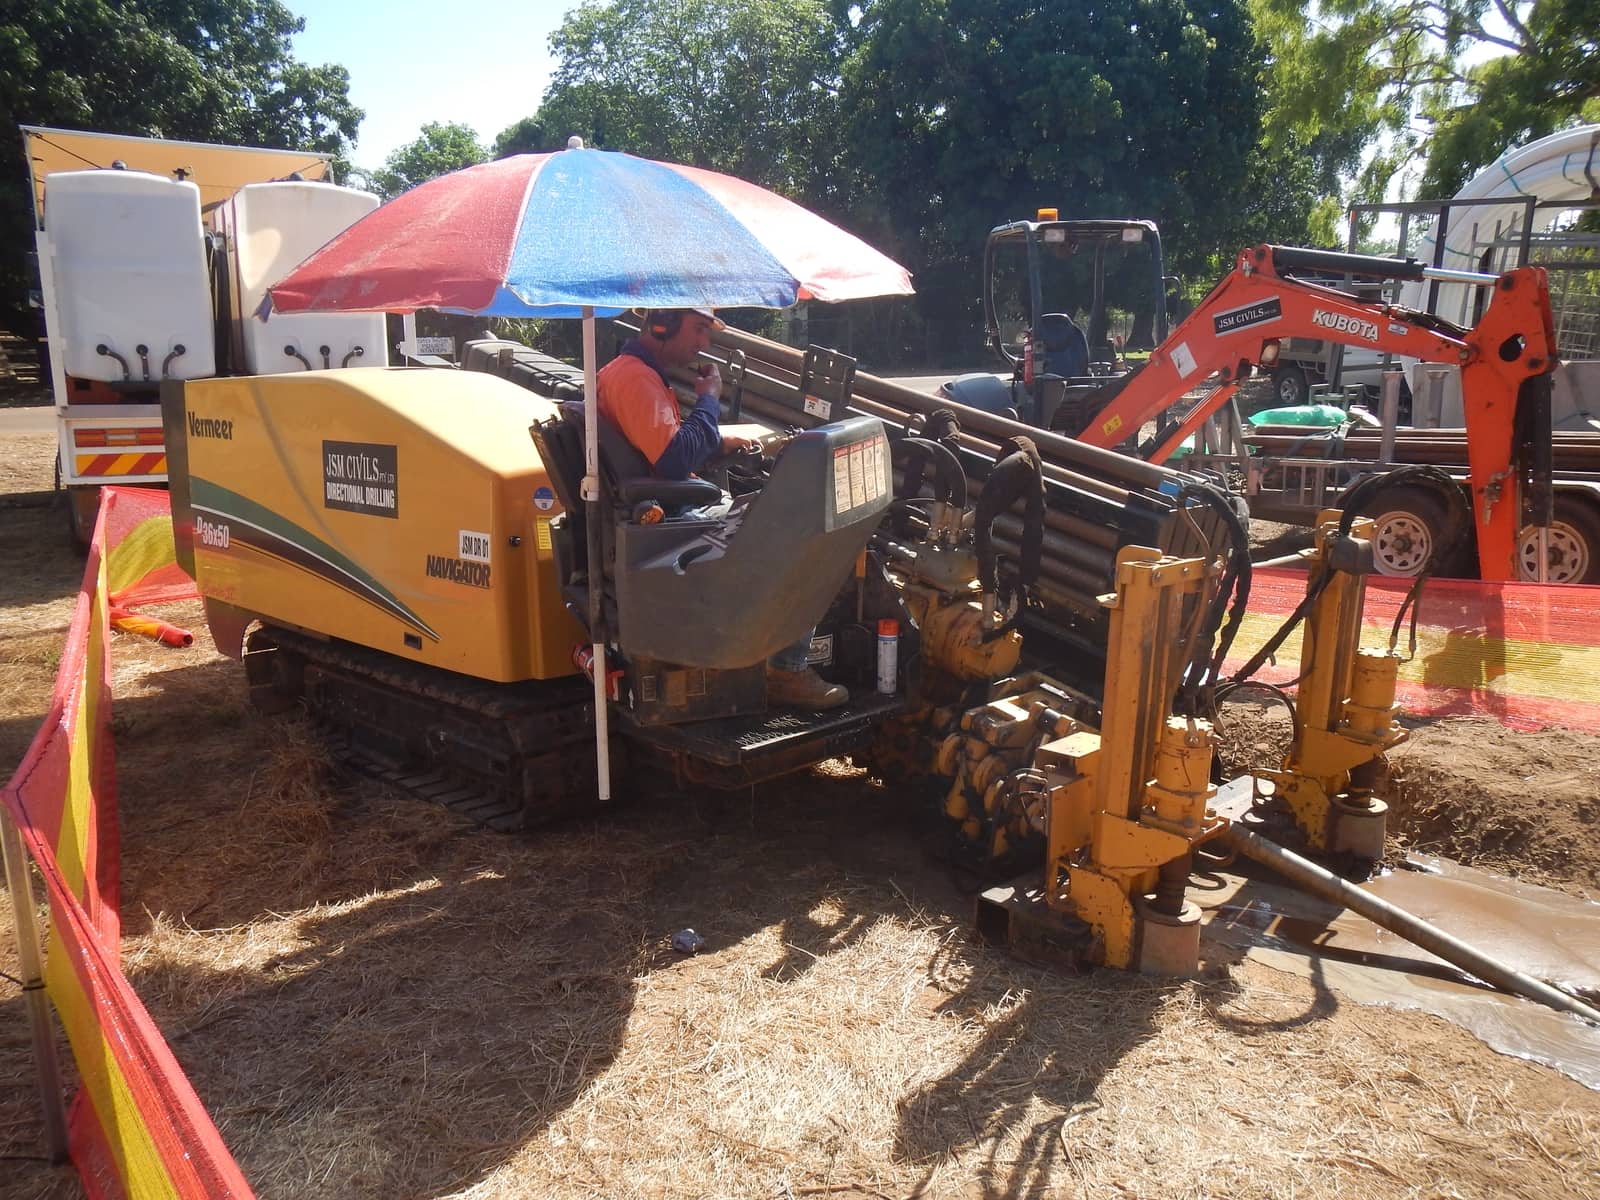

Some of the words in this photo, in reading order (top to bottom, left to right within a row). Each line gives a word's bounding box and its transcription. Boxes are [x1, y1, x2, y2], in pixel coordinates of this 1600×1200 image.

[1218, 316, 1235, 329] JSM
[1236, 307, 1264, 324] CIVILS
[1312, 309, 1379, 342] KUBOTA
[187, 411, 233, 440] Vermeer
[326, 453, 344, 478] JSM
[346, 452, 379, 481] CIVILS
[326, 481, 365, 505] DIRECTIONAL
[365, 486, 395, 509] DRILLING
[196, 515, 230, 549] D36x50
[462, 535, 473, 555] JSM
[473, 538, 481, 557] DR
[482, 539, 489, 558] 01
[426, 554, 491, 589] NAVIGATOR
